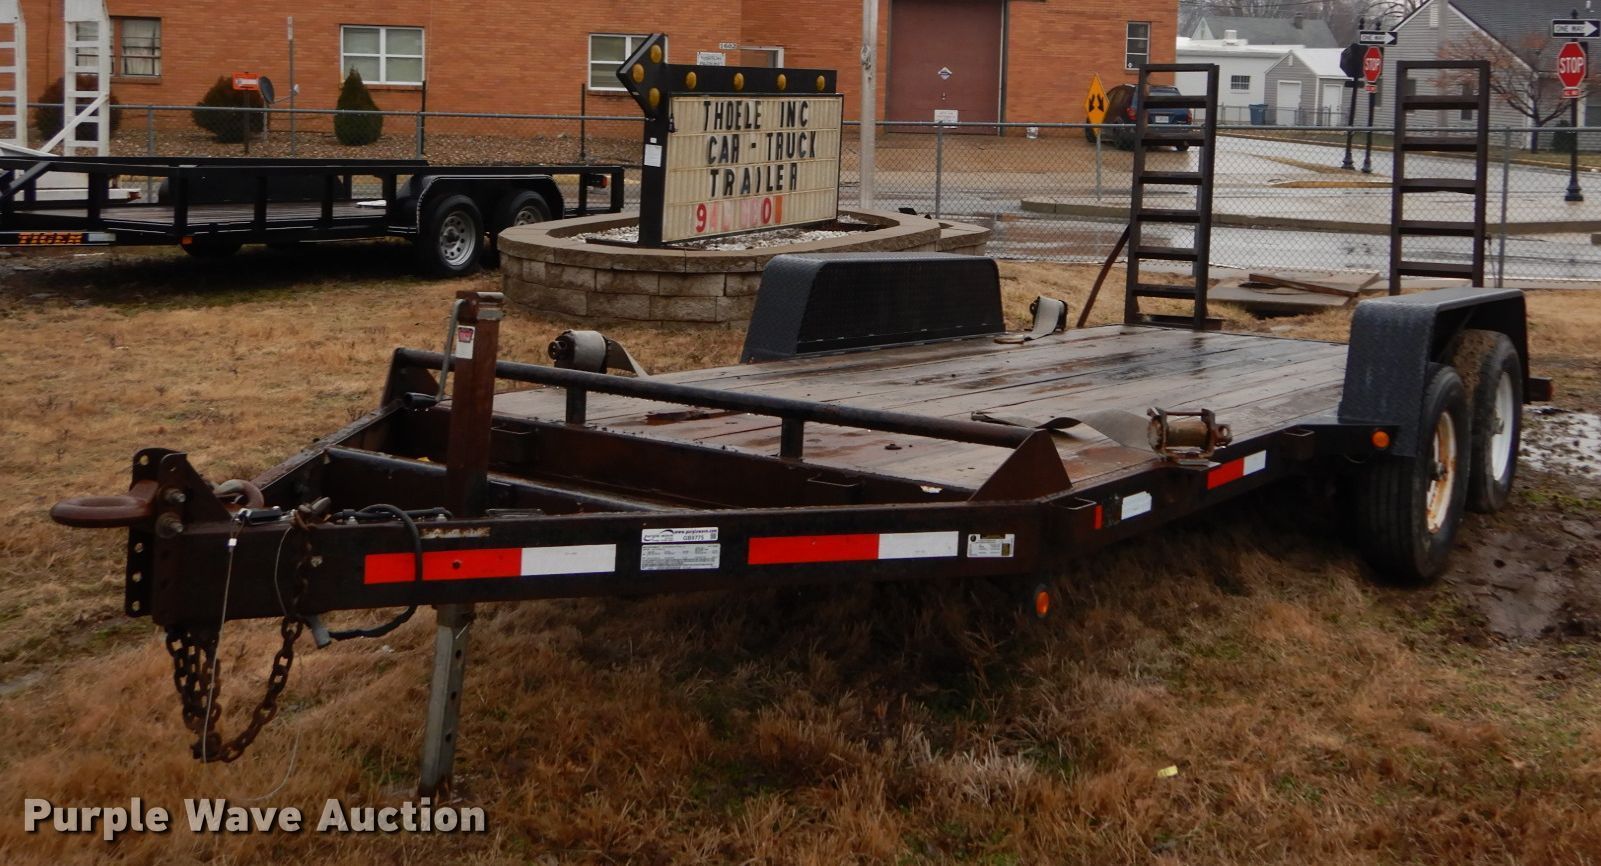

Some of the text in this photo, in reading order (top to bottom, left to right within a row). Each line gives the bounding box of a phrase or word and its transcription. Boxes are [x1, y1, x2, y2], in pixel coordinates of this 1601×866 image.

[1364, 58, 1380, 71] STOP
[1560, 57, 1584, 73] STOP
[703, 100, 808, 131] THOELE INC
[708, 134, 740, 164] CAR
[766, 130, 817, 161] TRUCK
[710, 163, 798, 198] TRAILER
[18, 232, 82, 245] TIGER
